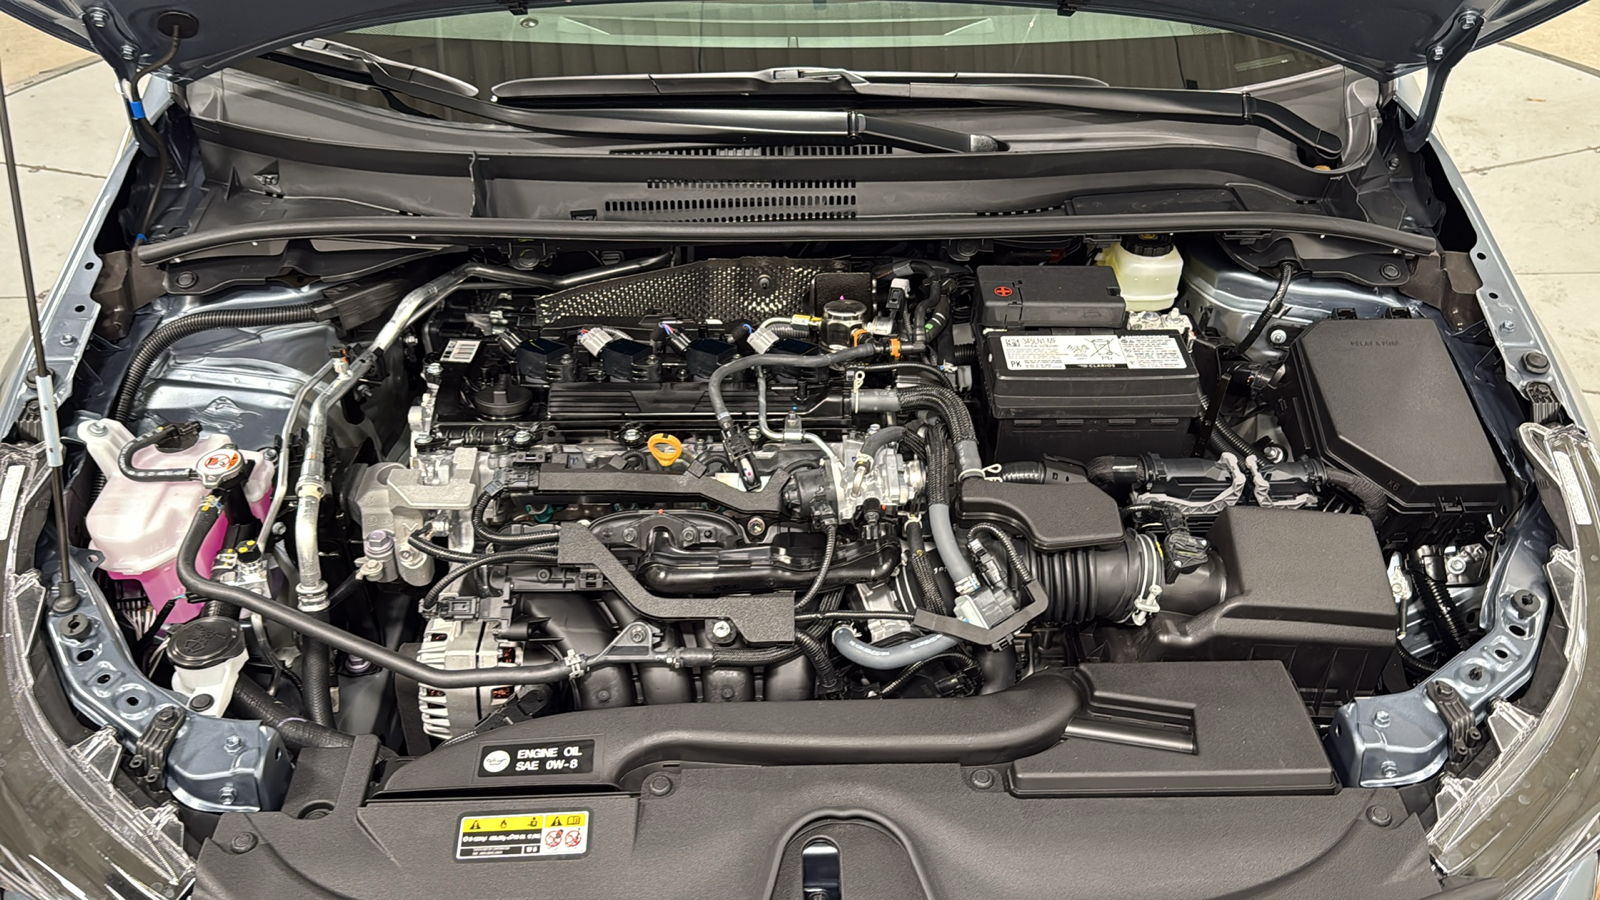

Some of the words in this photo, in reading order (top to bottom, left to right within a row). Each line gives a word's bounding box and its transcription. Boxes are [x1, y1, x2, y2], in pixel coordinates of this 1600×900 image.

[1010, 360, 1022, 368] PK
[517, 748, 558, 759] ENGINE
[563, 746, 583, 757] OIL
[515, 760, 540, 771] SAE
[545, 759, 578, 770] 0W-8
